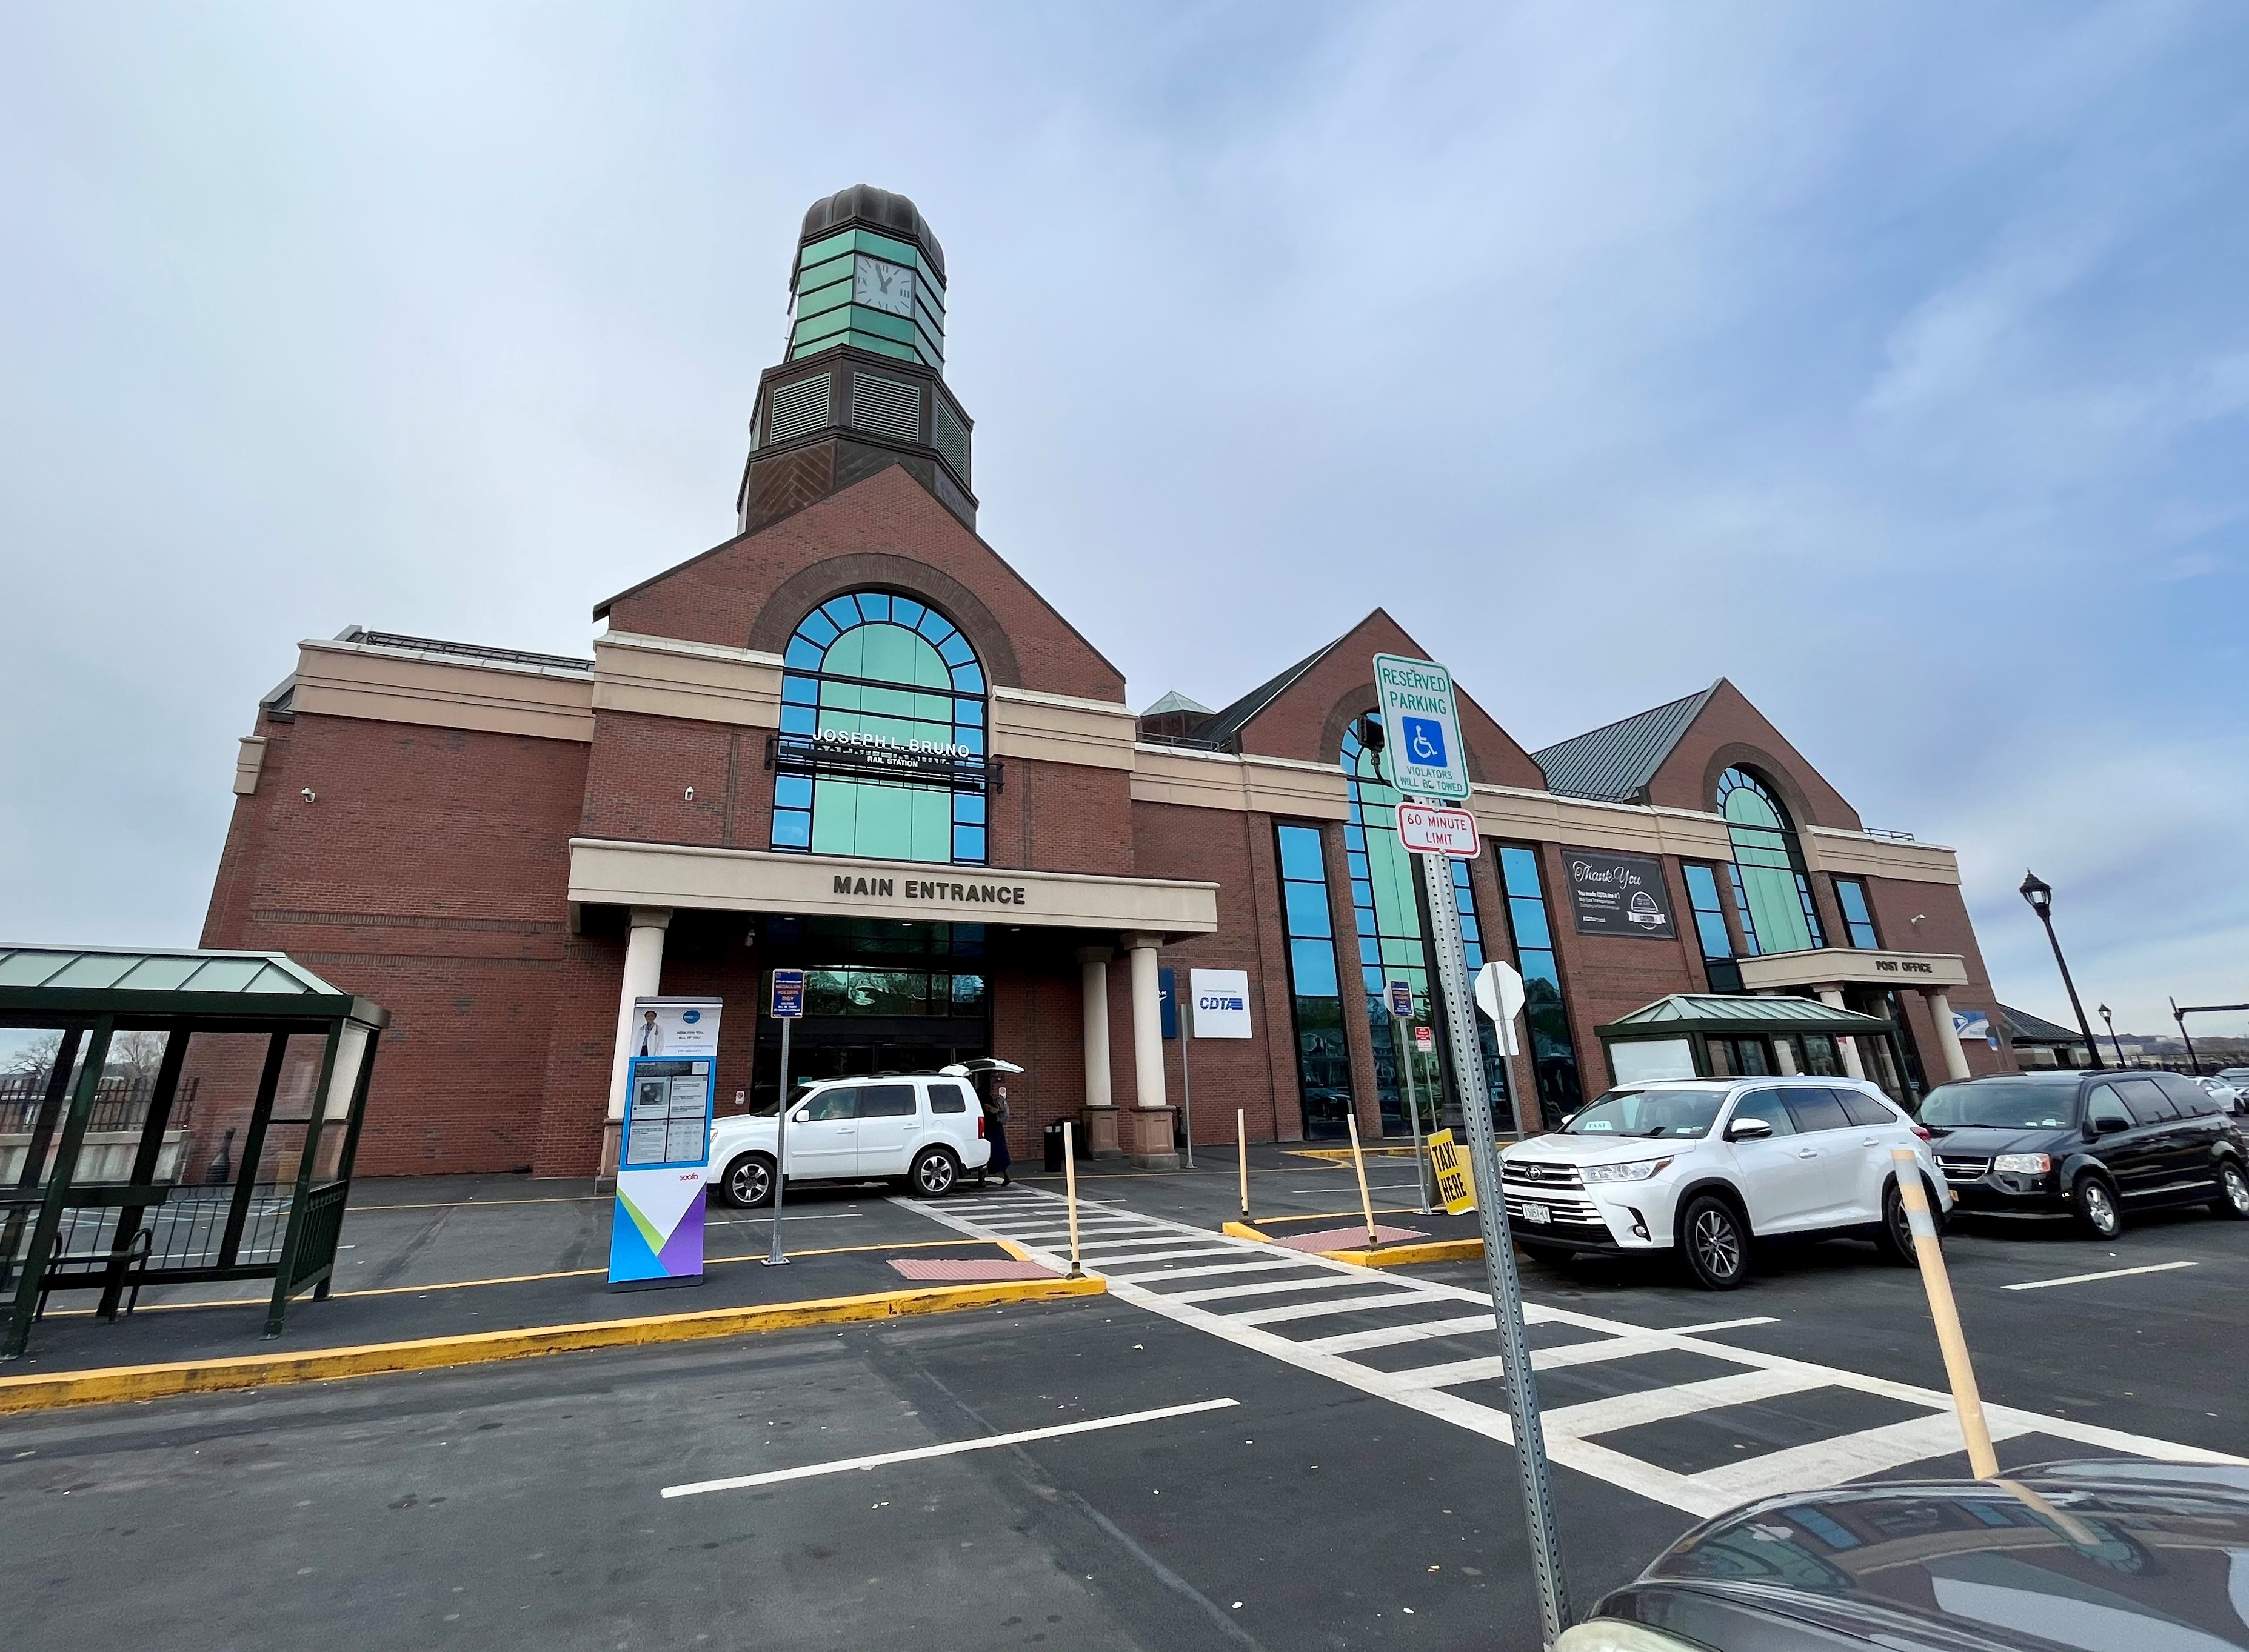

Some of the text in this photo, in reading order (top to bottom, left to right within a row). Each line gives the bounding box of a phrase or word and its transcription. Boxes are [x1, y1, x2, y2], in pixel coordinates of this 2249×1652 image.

[1382, 667, 1446, 693] RESERVED
[1389, 691, 1446, 715] PARKING
[812, 727, 970, 758] JOSEPH L. BRUNO
[867, 755, 918, 768] RAIL STATION
[1406, 766, 1452, 780] VIOLATORS
[1400, 776, 1419, 787] WILL
[1435, 781, 1462, 792] TOWED
[1408, 813, 1467, 831] 60 MINUTE
[1426, 831, 1452, 846] LIMIT
[1572, 861, 1642, 890] Thank You
[834, 875, 1026, 905] MAIN ENTRANCE
[1875, 960, 1933, 973] POST OFFICE
[1200, 996, 1243, 1010] CDTA
[1431, 1141, 1459, 1173] TAXI
[1440, 1172, 1468, 1204] HERE
